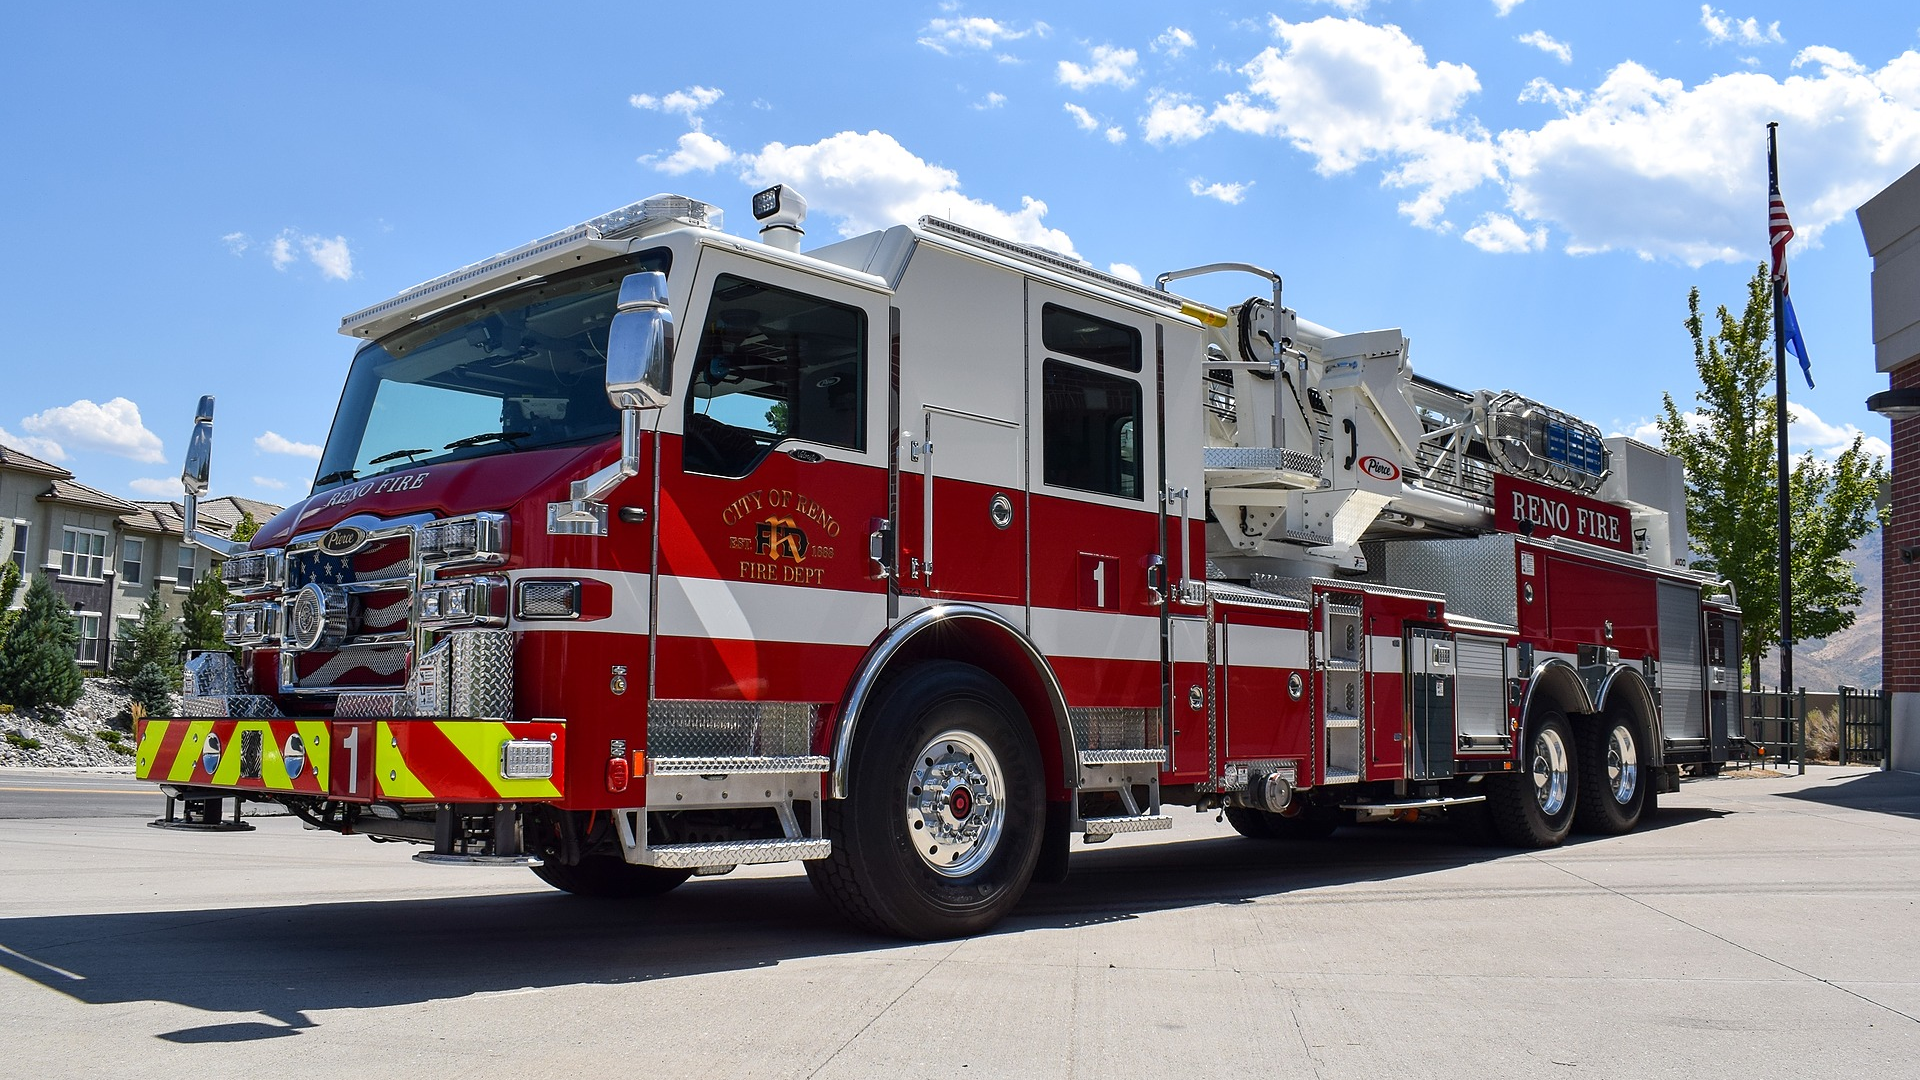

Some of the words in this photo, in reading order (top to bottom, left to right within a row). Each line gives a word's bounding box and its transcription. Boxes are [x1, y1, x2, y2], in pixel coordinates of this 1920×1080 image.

[1368, 459, 1391, 476] Pierce
[326, 482, 375, 506] RENO
[375, 473, 429, 494] FIRE
[722, 490, 763, 526] CITY
[769, 489, 792, 507] OF
[795, 494, 840, 537] RENO
[1511, 491, 1570, 531] RENO
[1576, 507, 1621, 543] FIRE
[327, 530, 354, 548] Pierce
[740, 561, 777, 581] FIRE
[783, 565, 824, 585] DEPT
[1093, 561, 1105, 607] 1
[343, 726, 358, 794] 1
